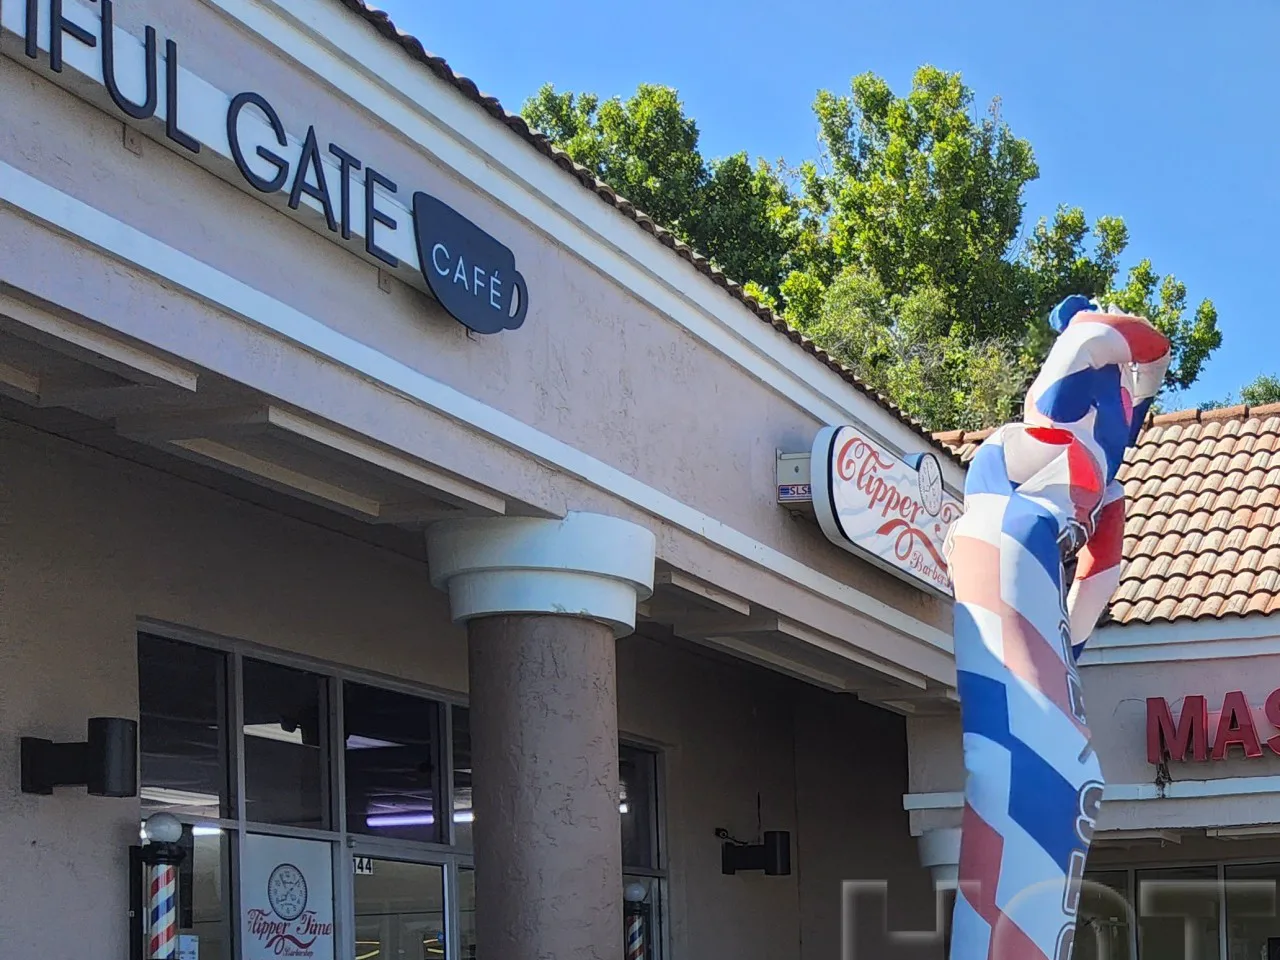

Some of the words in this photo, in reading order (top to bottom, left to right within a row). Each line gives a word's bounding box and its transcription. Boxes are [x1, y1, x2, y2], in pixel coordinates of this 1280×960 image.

[24, 0, 199, 153] IFUL
[227, 92, 398, 268] GATE
[432, 242, 502, 311] CAFÉ
[790, 486, 807, 495] SLS
[837, 437, 924, 523] Clipper
[910, 551, 952, 588] Barbers
[353, 858, 371, 873] 144
[296, 910, 332, 935] Time
